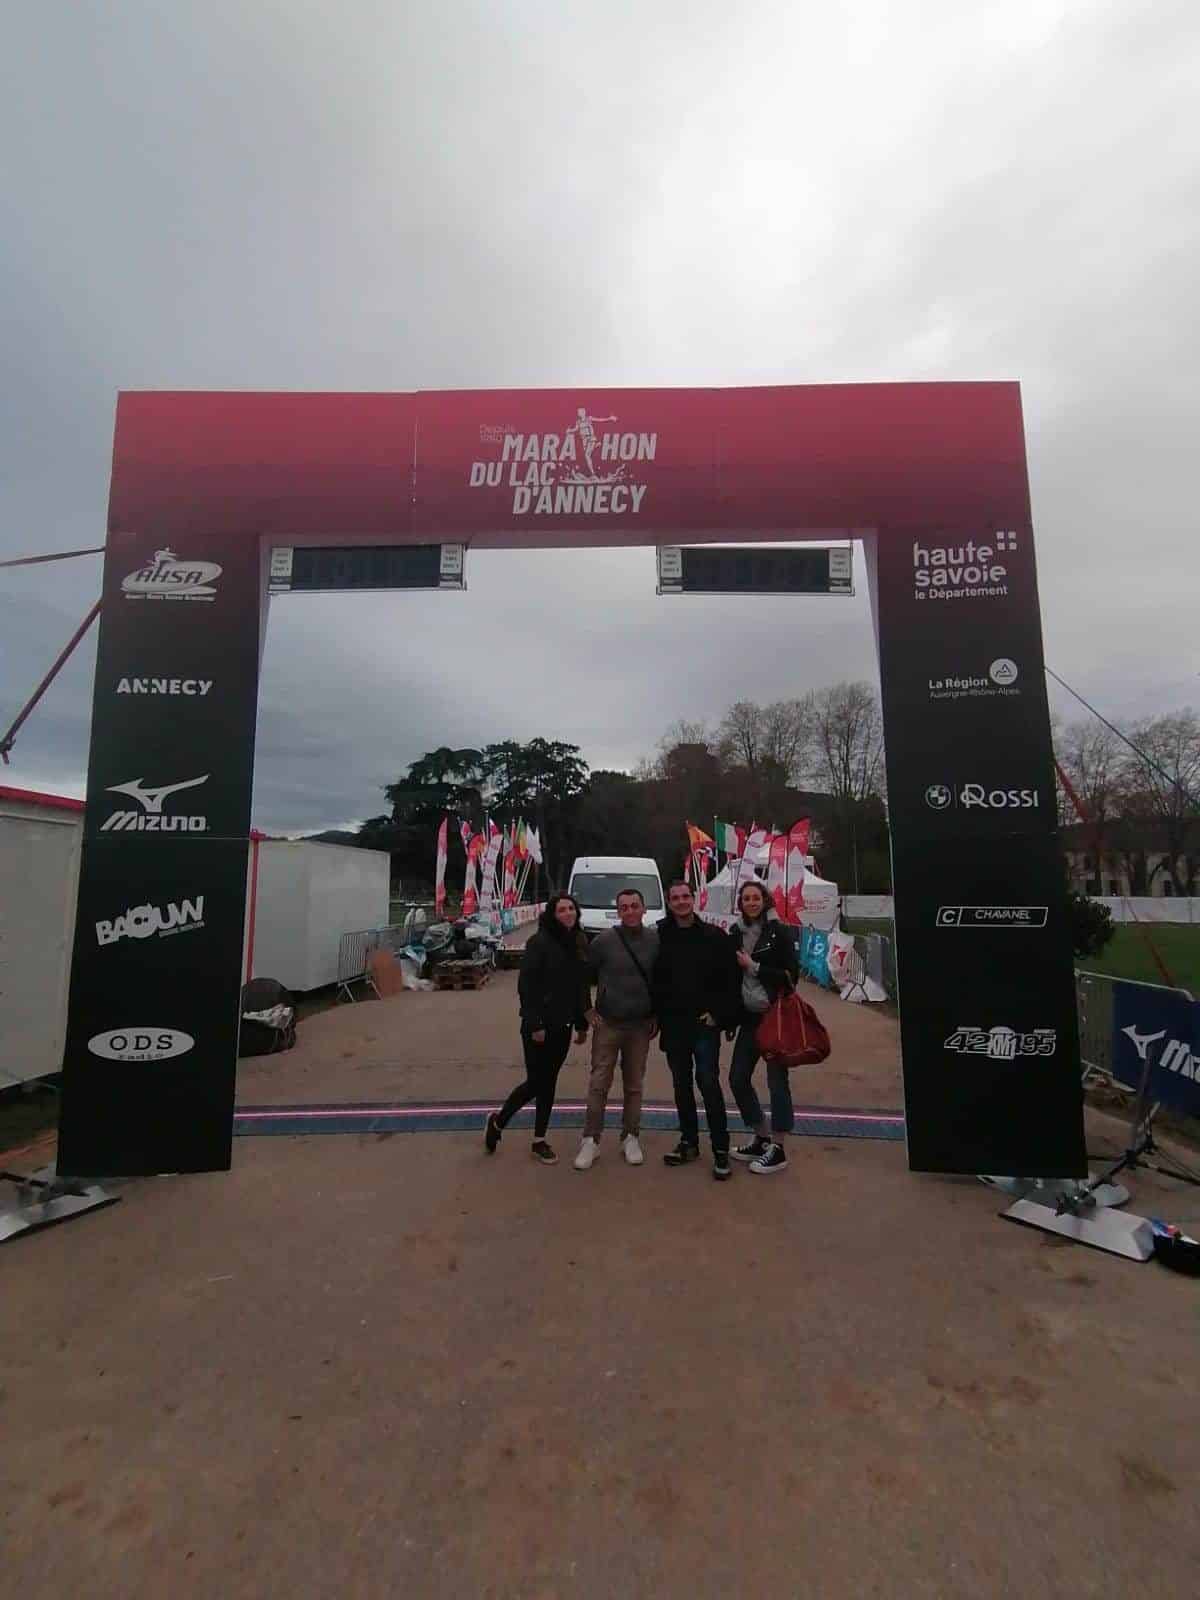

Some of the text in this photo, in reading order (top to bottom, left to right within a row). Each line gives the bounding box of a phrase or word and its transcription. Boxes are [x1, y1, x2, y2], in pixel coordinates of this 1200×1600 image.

[470, 462, 557, 487] DU LAC
[513, 485, 647, 515] D'ANNECY
[913, 541, 994, 567] haute
[134, 567, 203, 585] AHSA
[915, 565, 1007, 587] savoie
[915, 585, 1008, 601] le Département
[116, 677, 213, 697] ANNECY
[929, 679, 943, 689] La
[942, 909, 956, 923] C
[975, 909, 1031, 920] CHAVANEL
[109, 1034, 173, 1051] ODS
